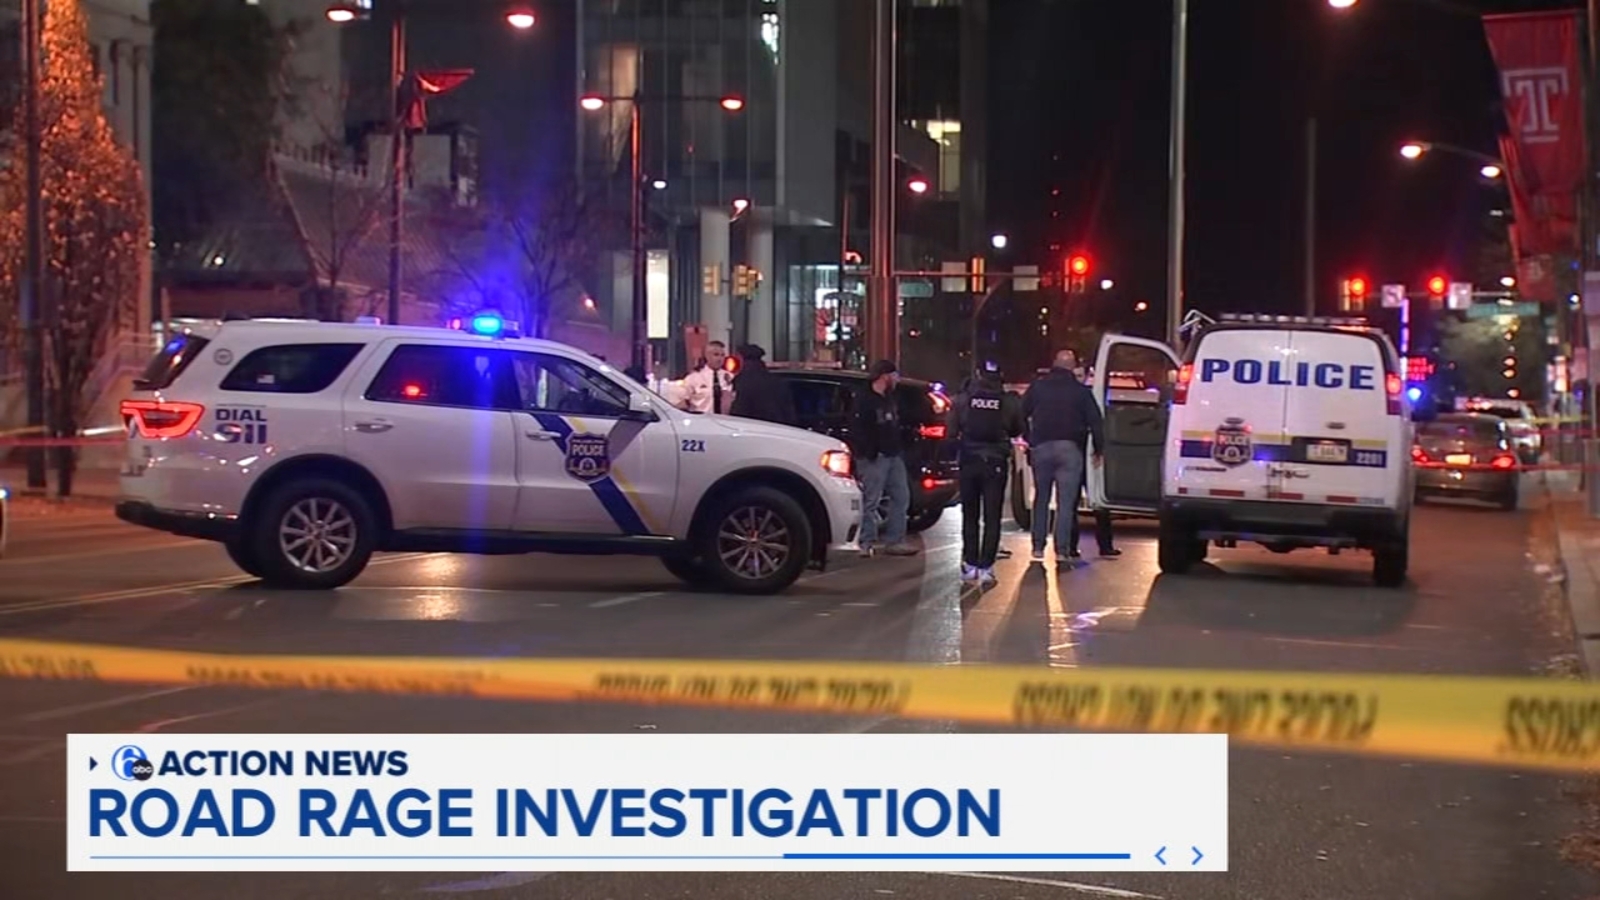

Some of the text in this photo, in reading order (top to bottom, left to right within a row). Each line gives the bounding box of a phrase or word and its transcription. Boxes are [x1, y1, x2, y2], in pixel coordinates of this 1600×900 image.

[1503, 66, 1569, 143] T
[1201, 358, 1375, 390] POLICE
[971, 398, 1000, 410] POLICE
[215, 409, 267, 421] DIAL
[215, 423, 267, 444] 911
[681, 439, 706, 452] 22X
[1219, 434, 1251, 447] POLICE
[573, 444, 605, 456] POLICE
